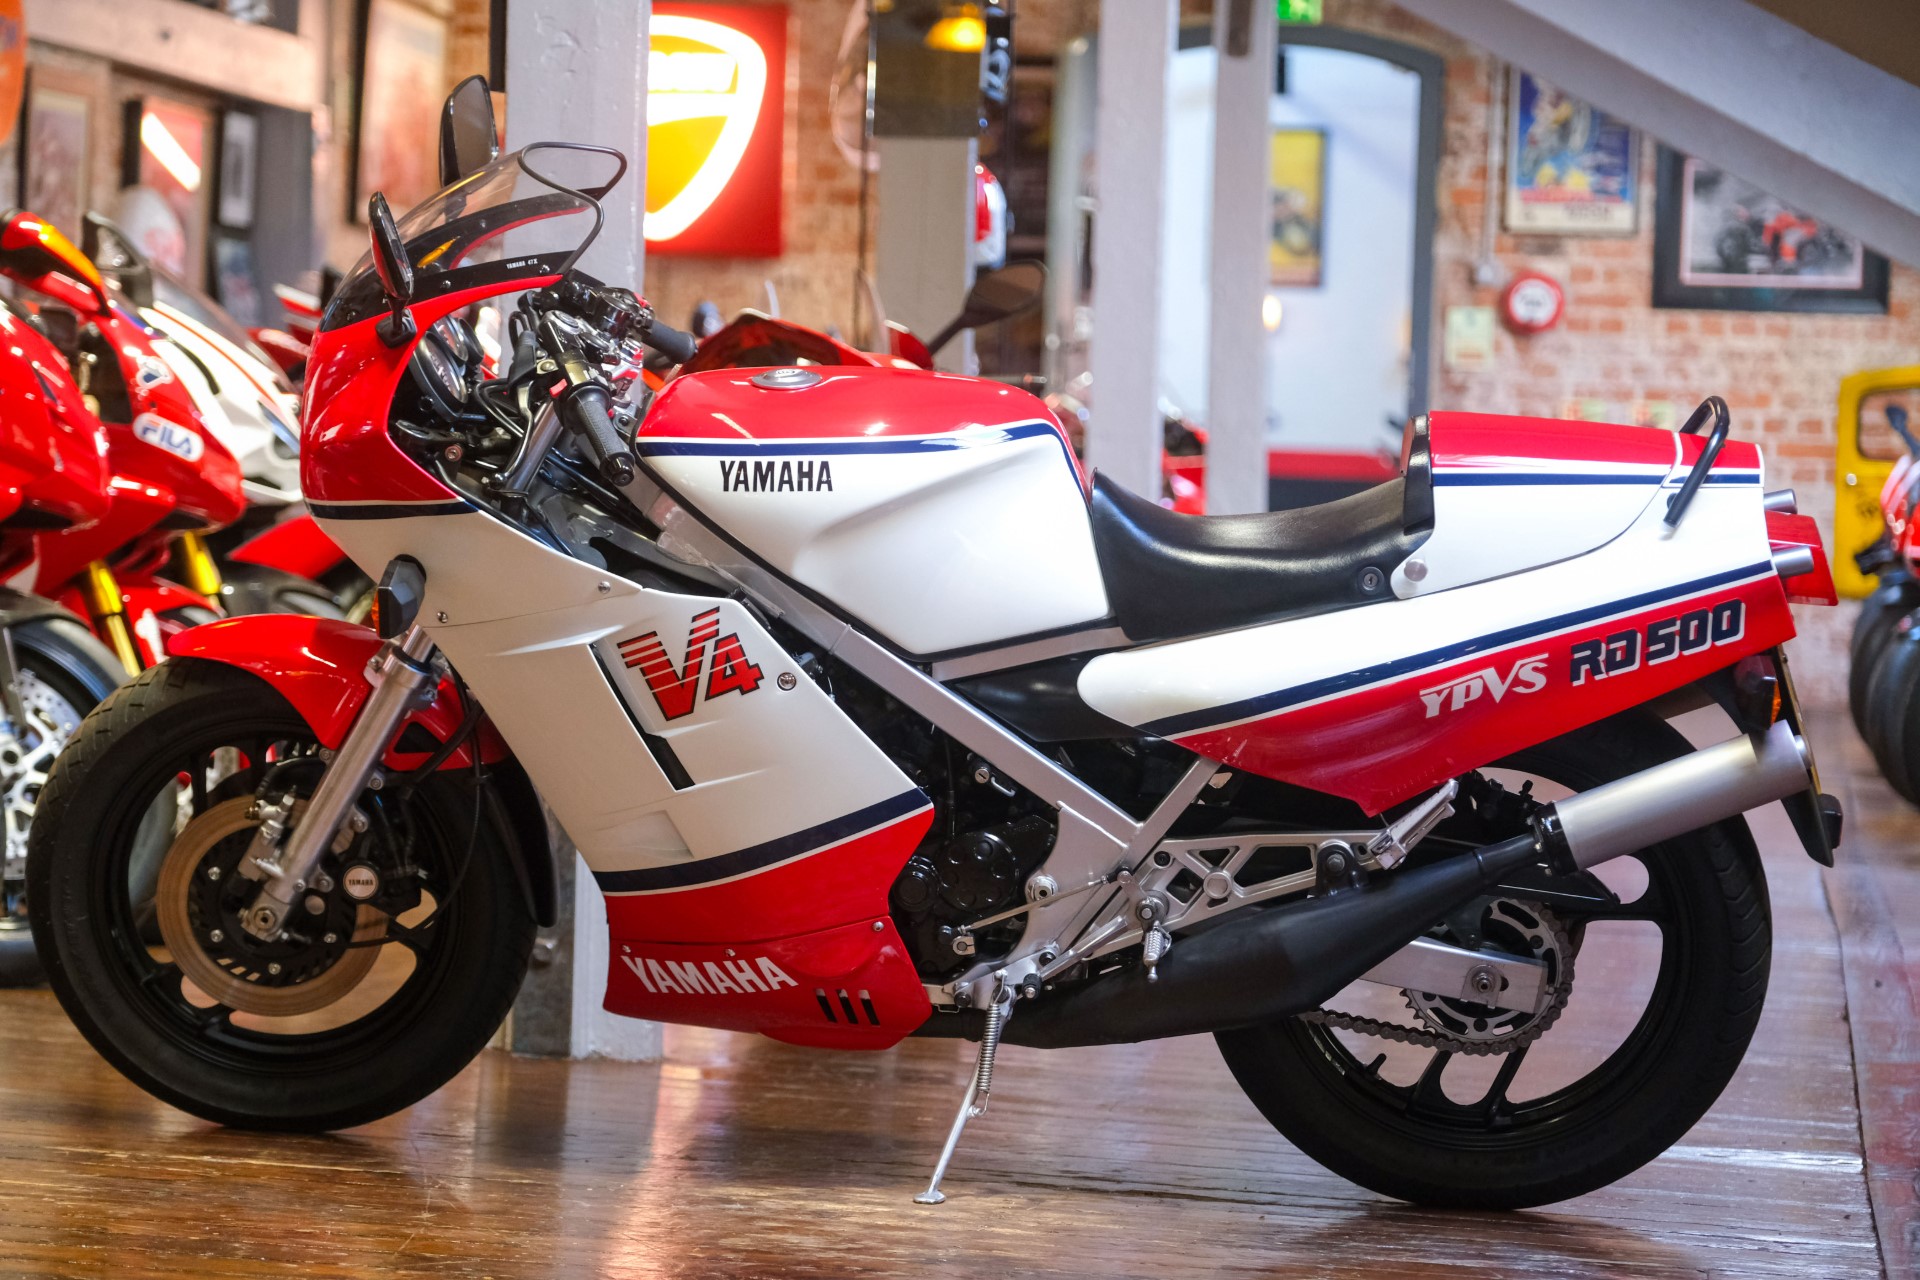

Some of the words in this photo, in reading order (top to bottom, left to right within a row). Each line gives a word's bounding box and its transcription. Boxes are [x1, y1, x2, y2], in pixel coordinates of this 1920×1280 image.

[506, 260, 526, 269] YAMAHA
[142, 420, 192, 457] FILA
[719, 460, 834, 492] YAMAHA
[616, 605, 765, 722] V4
[1419, 652, 1549, 719] YPVS
[1645, 598, 1746, 666] 500
[620, 955, 800, 995] YAMAHA
